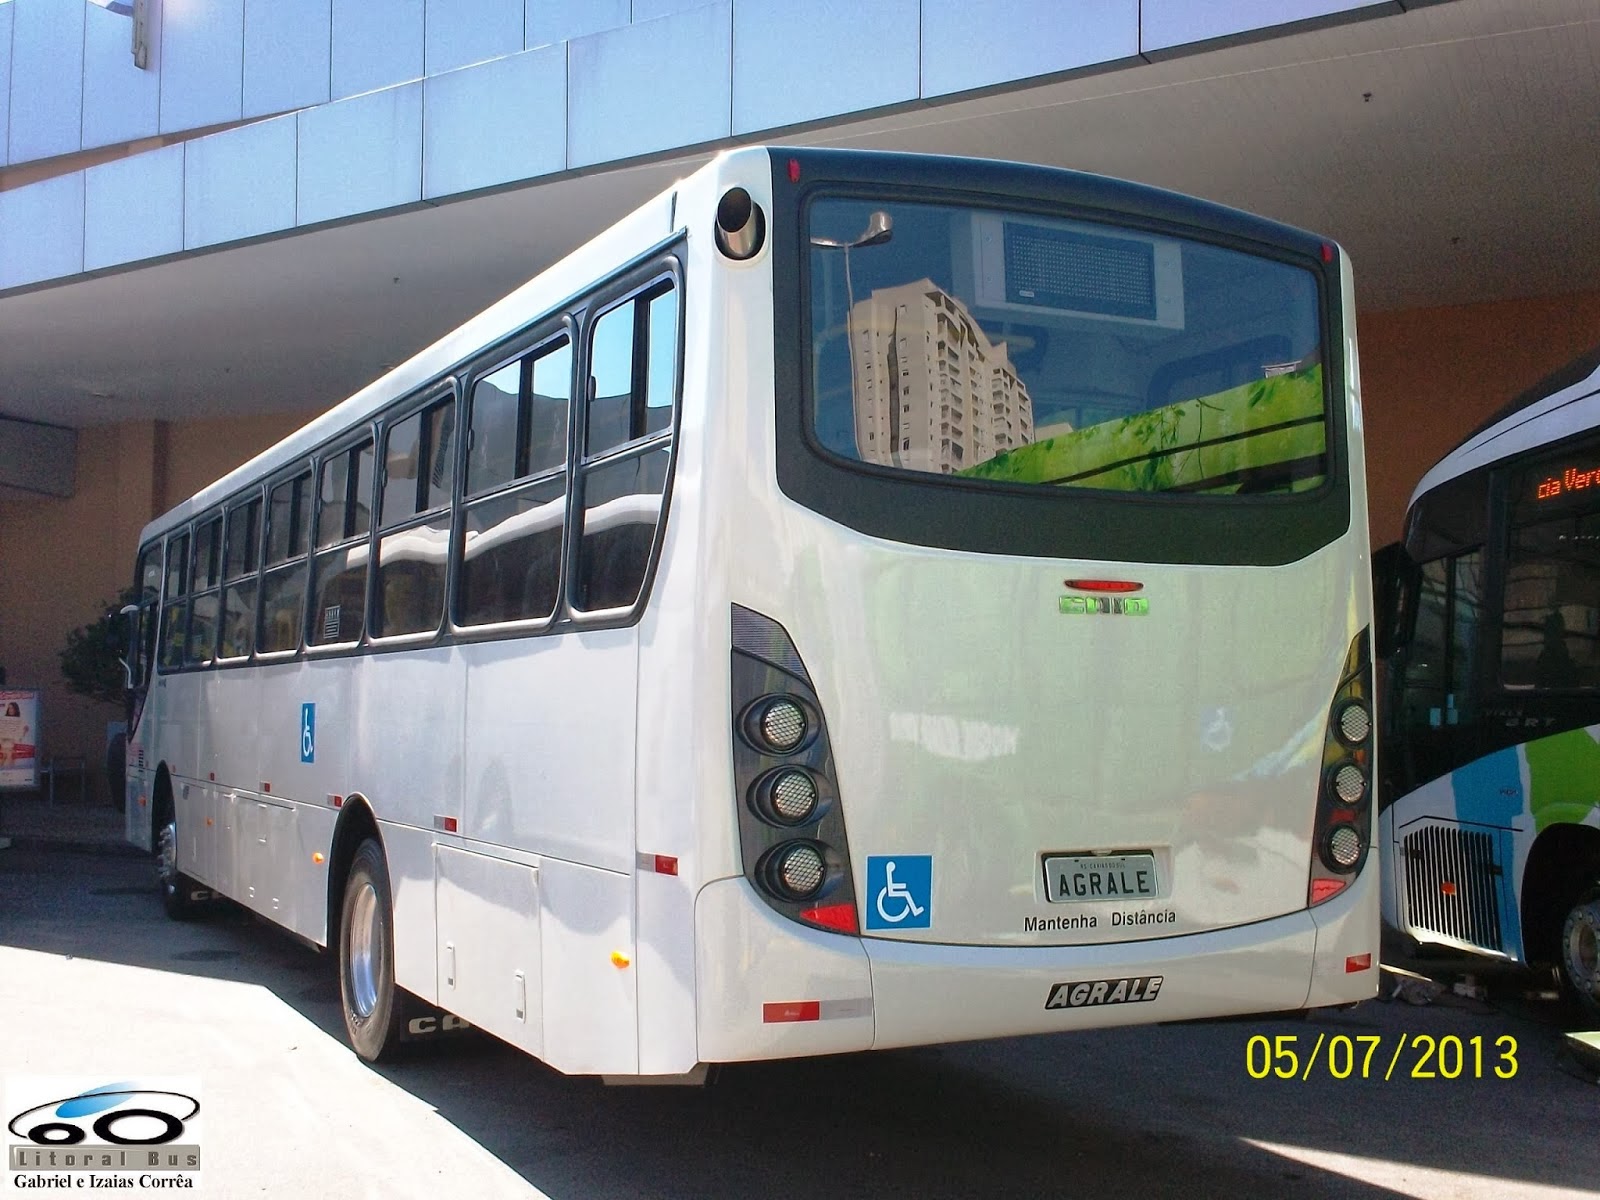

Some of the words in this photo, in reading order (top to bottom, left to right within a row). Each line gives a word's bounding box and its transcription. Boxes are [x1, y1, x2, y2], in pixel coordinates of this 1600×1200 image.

[1059, 871, 1150, 896] AGRALE
[1024, 914, 1097, 931] Mantenha
[1111, 909, 1176, 926] Distância
[1047, 977, 1162, 1008] AGRALE
